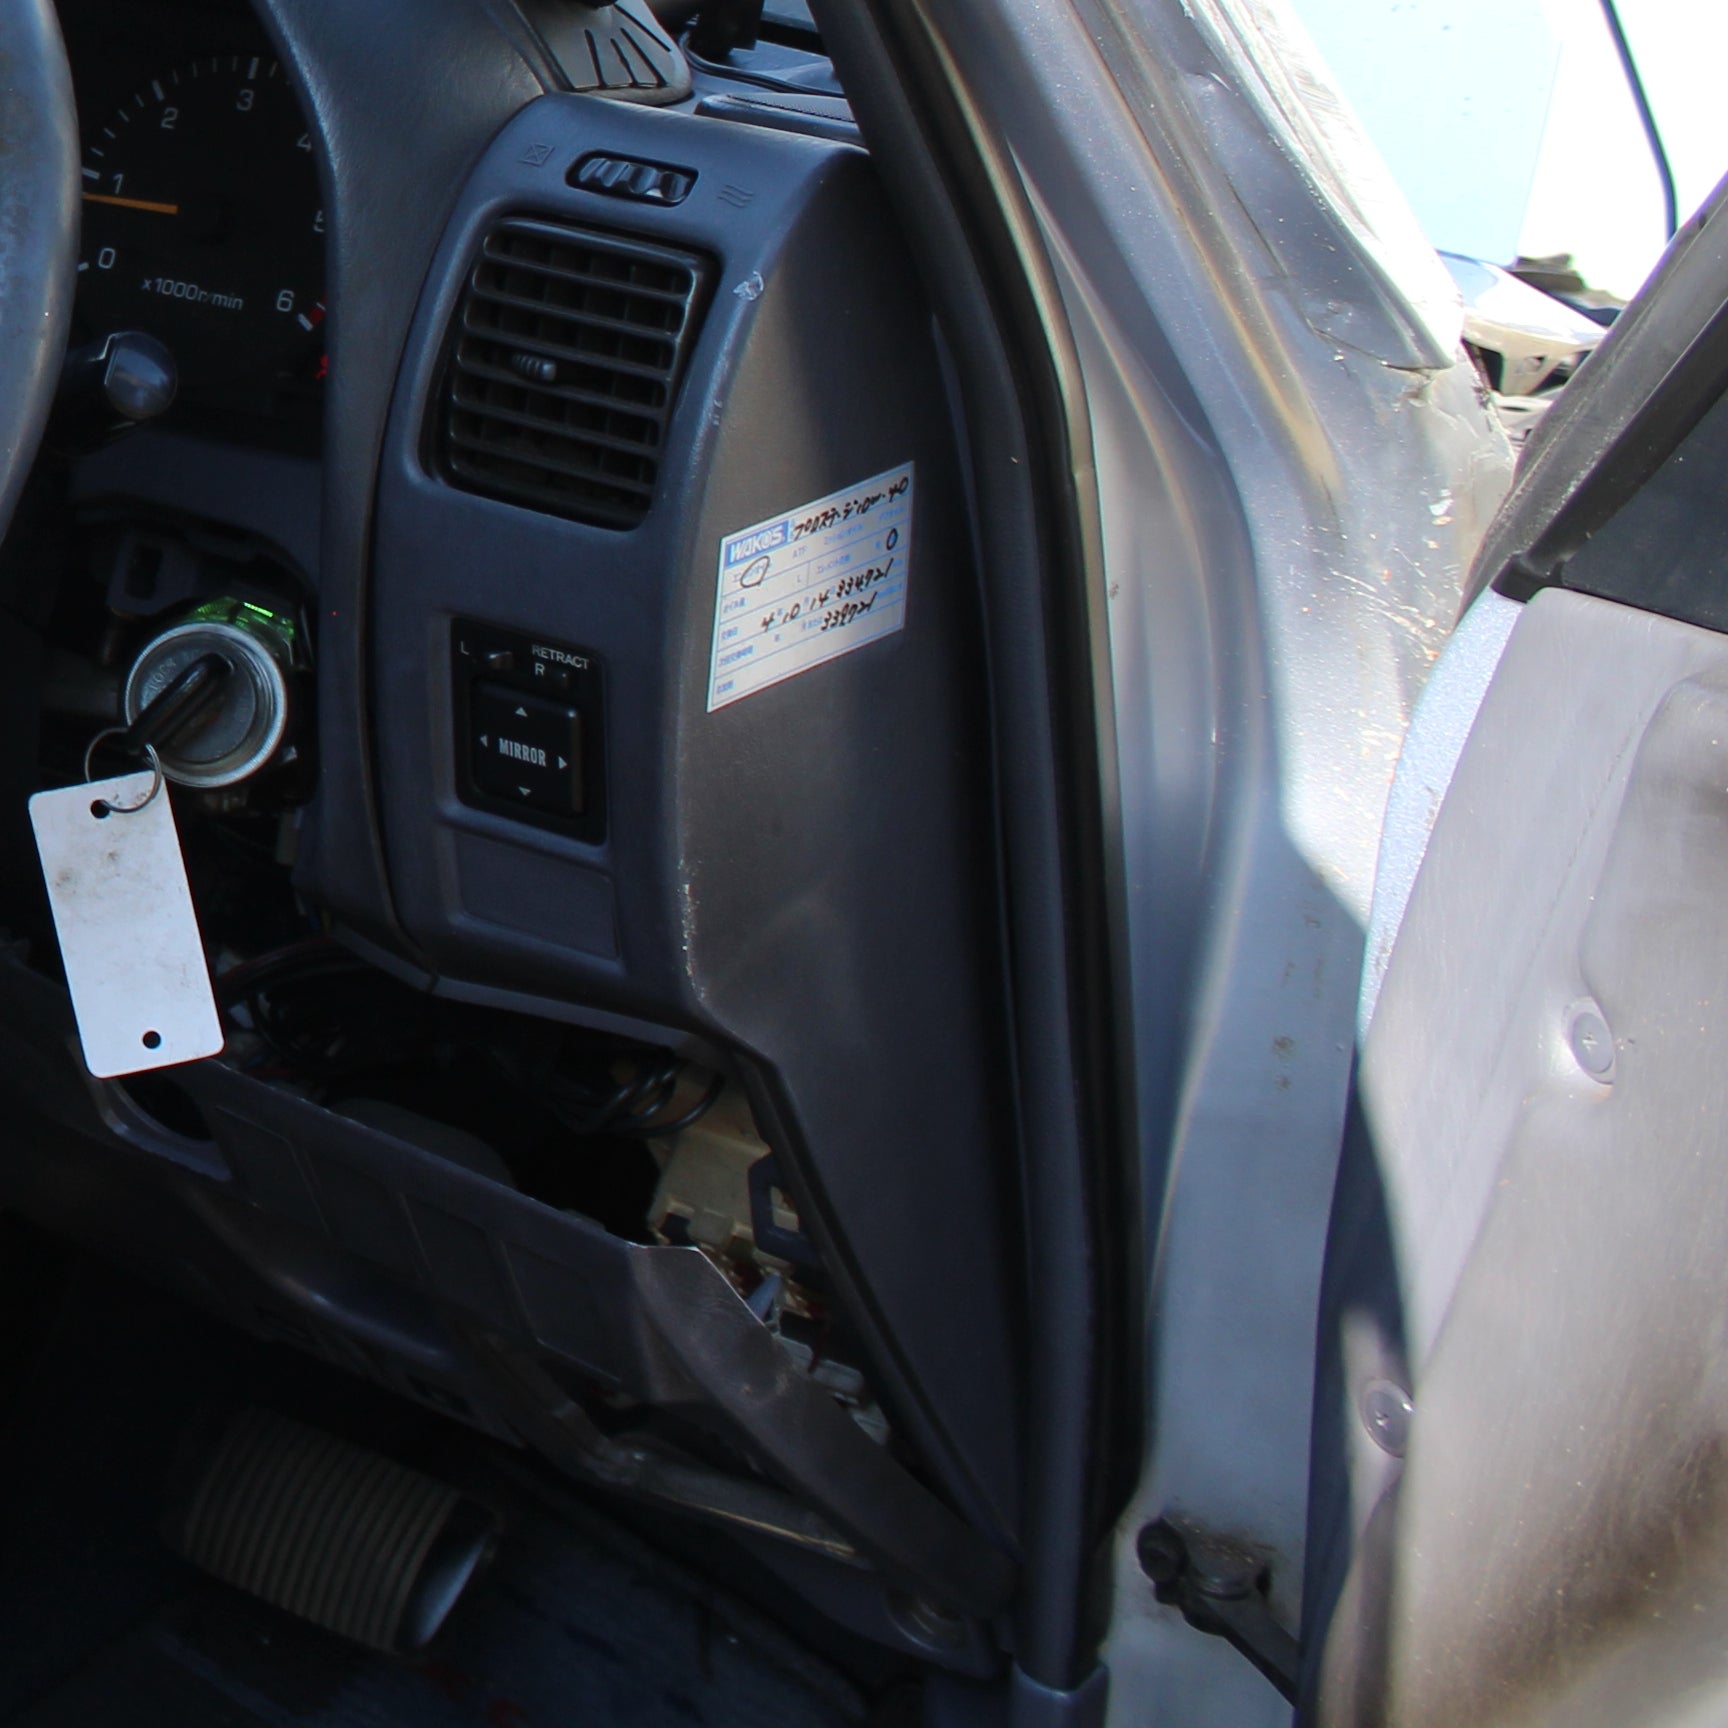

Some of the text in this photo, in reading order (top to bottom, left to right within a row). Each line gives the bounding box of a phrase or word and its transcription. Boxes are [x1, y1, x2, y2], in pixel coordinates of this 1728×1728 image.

[236, 89, 254, 111] 3
[160, 107, 178, 129] 2
[113, 173, 124, 194] 1
[98, 247, 116, 270] 0
[276, 289, 294, 312] 6
[460, 641, 470, 656] L
[531, 644, 589, 670] RETRACT
[535, 662, 545, 676] R
[498, 737, 547, 768] MIRROR
